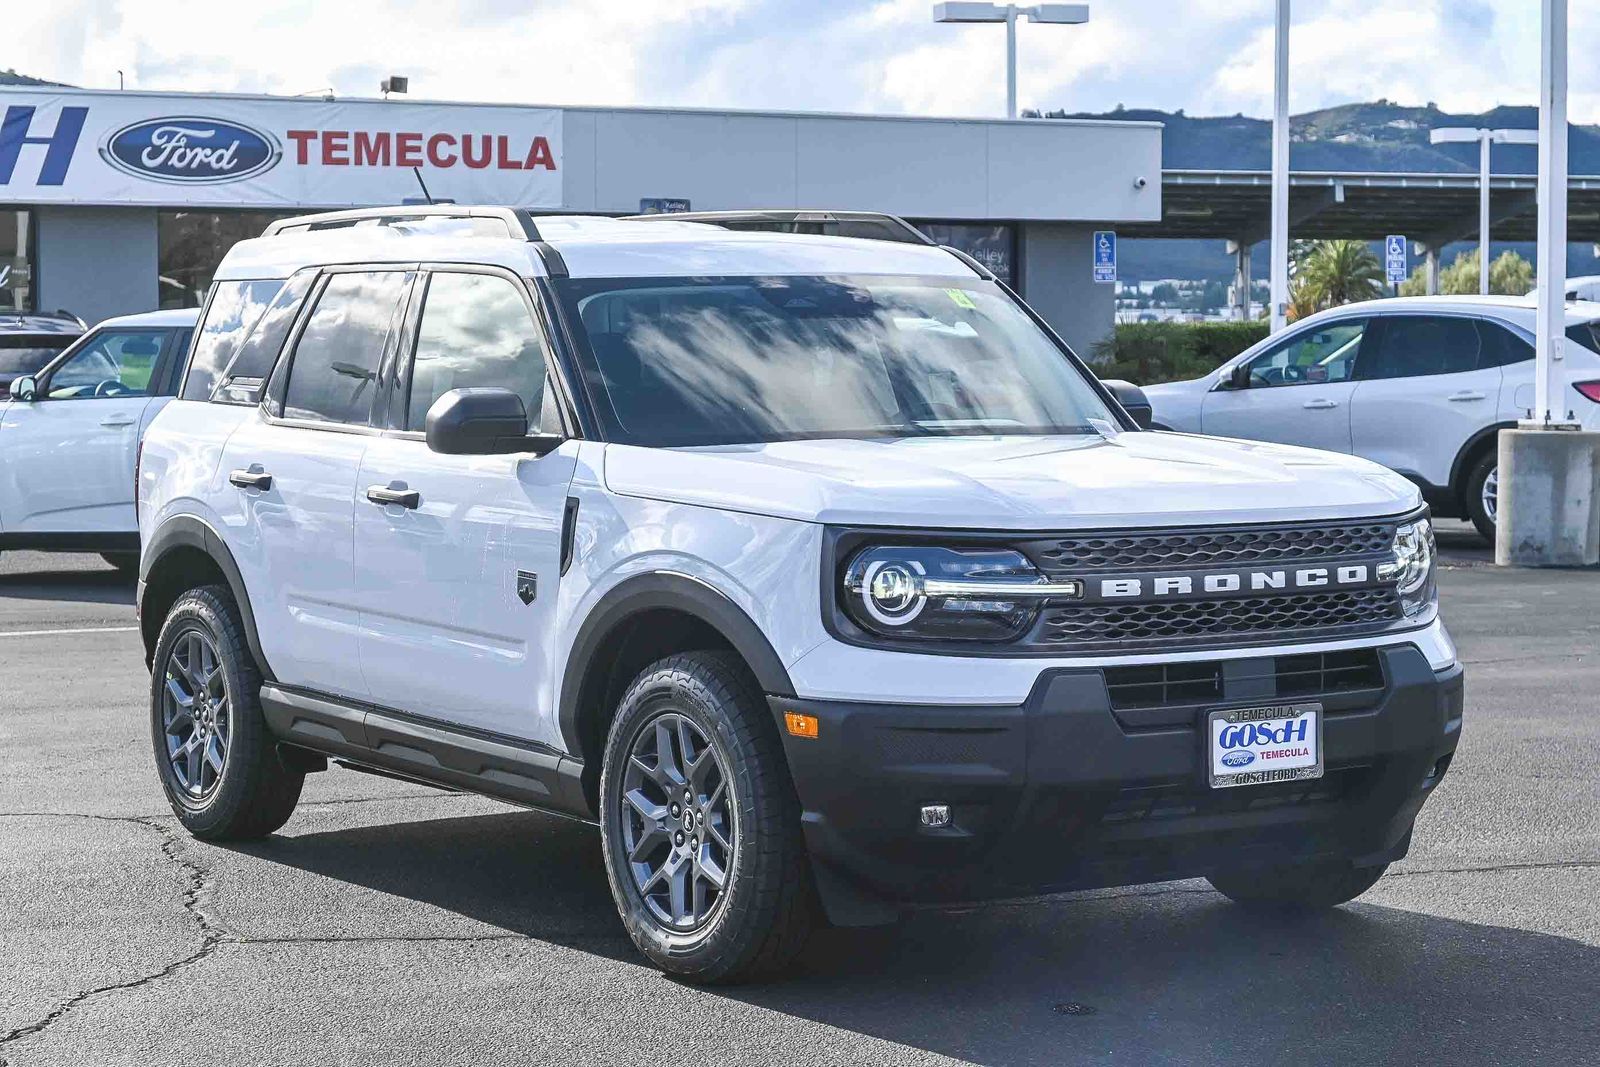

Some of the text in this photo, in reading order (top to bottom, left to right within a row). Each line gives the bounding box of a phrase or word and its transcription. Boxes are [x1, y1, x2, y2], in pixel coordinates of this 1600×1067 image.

[142, 127, 239, 170] Ford
[287, 130, 556, 171] TEMECULA
[1101, 566, 1367, 597] BRONCO
[1237, 706, 1295, 721] TEMECULA
[1227, 747, 1309, 766] Ford TEMECULA
